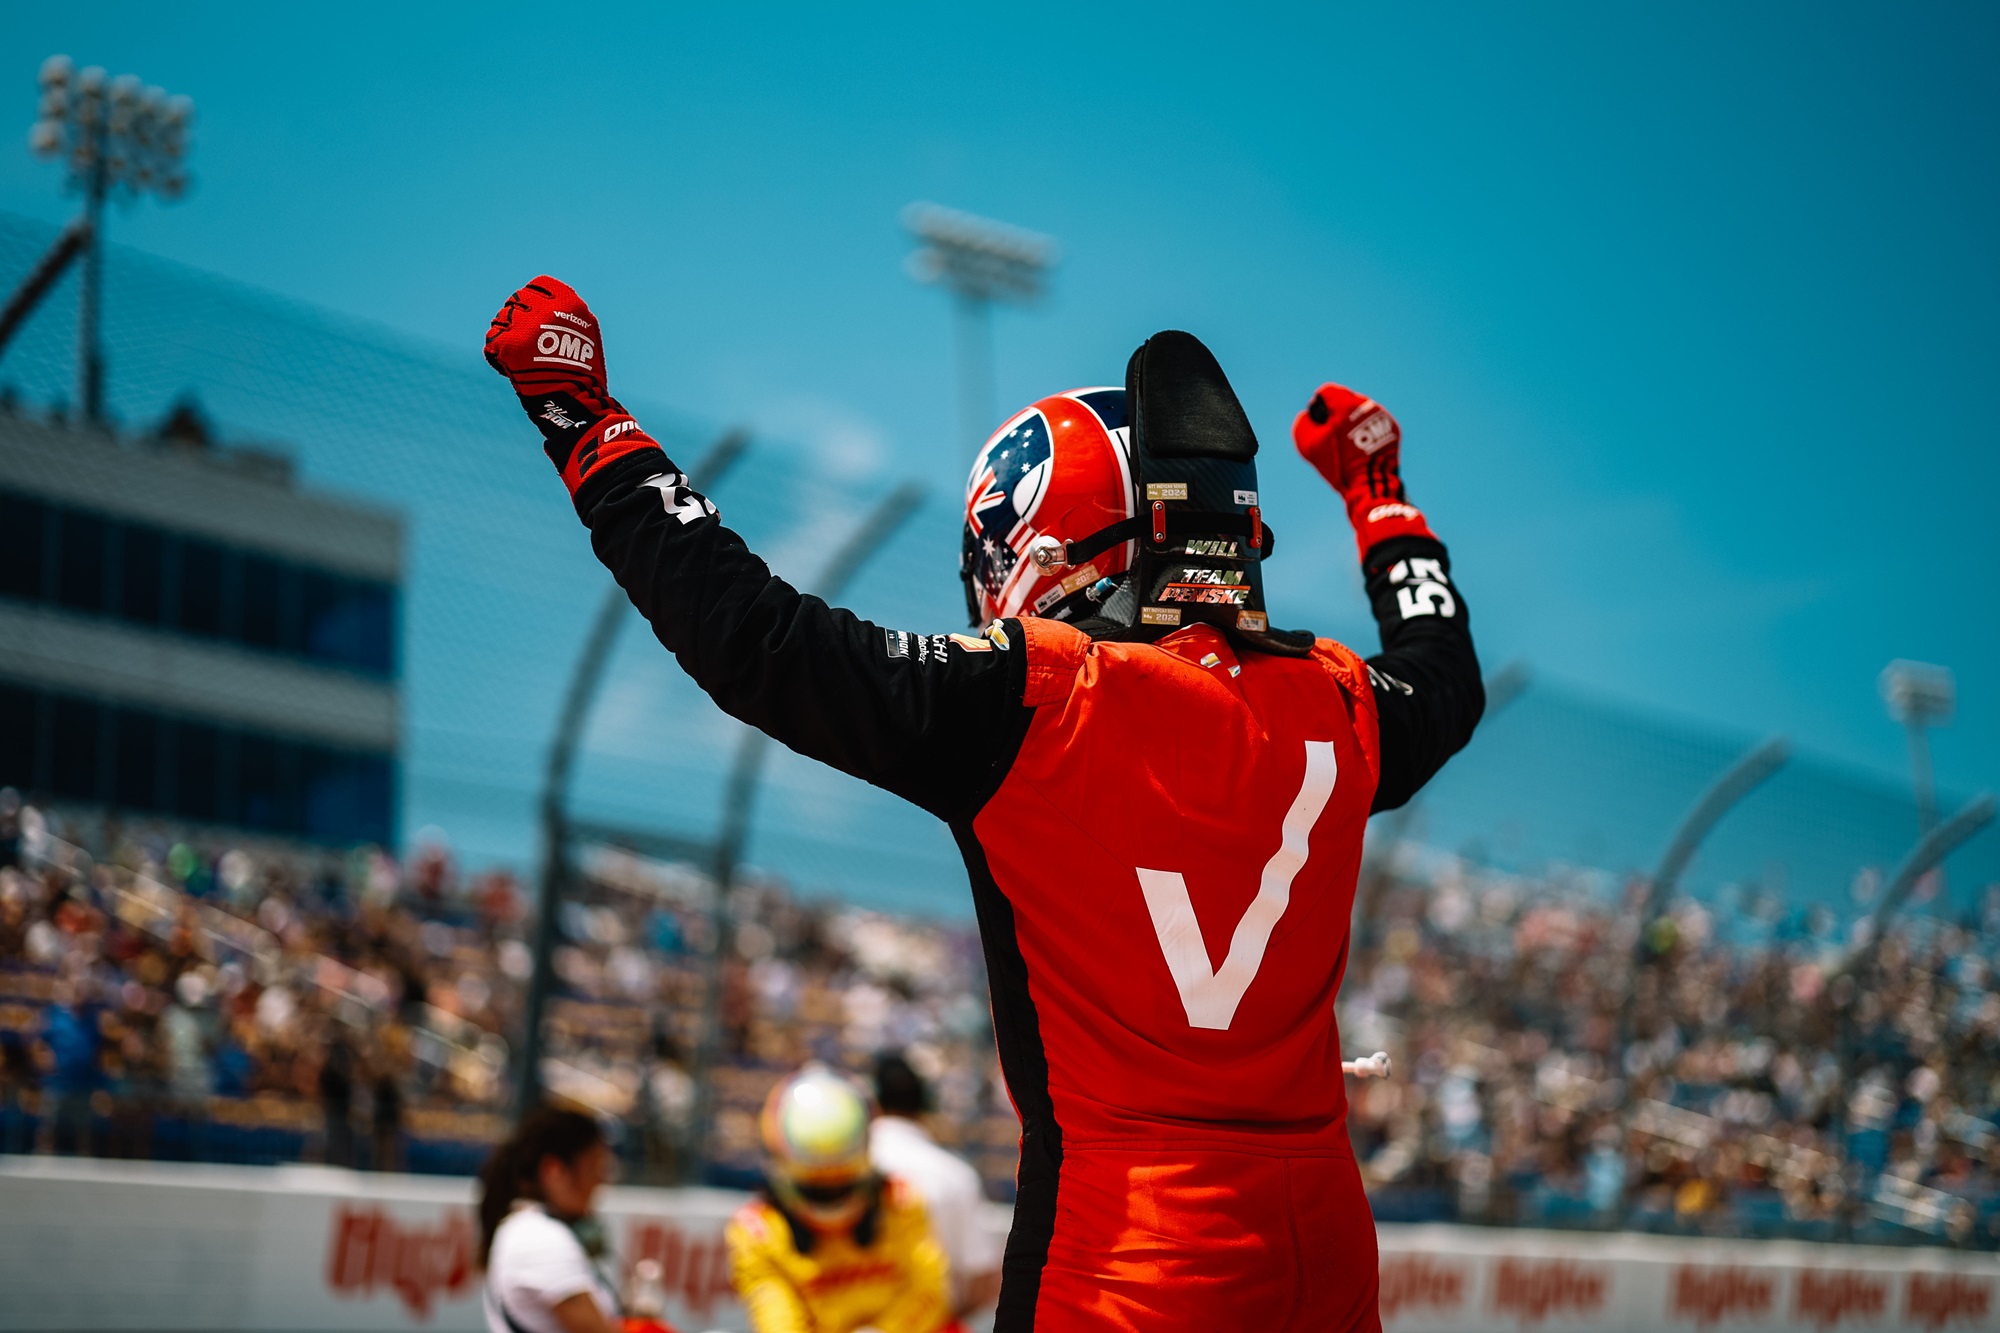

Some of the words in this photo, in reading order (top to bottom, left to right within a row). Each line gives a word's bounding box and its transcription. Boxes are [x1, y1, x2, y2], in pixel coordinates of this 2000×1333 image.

[553, 310, 589, 329] verizon
[537, 331, 594, 363] OMP
[1161, 488, 1187, 497] 2024
[1185, 539, 1238, 557] WILL
[1180, 568, 1244, 585] TEAM
[1158, 587, 1249, 604] PENSKE
[1155, 613, 1179, 621] 2024
